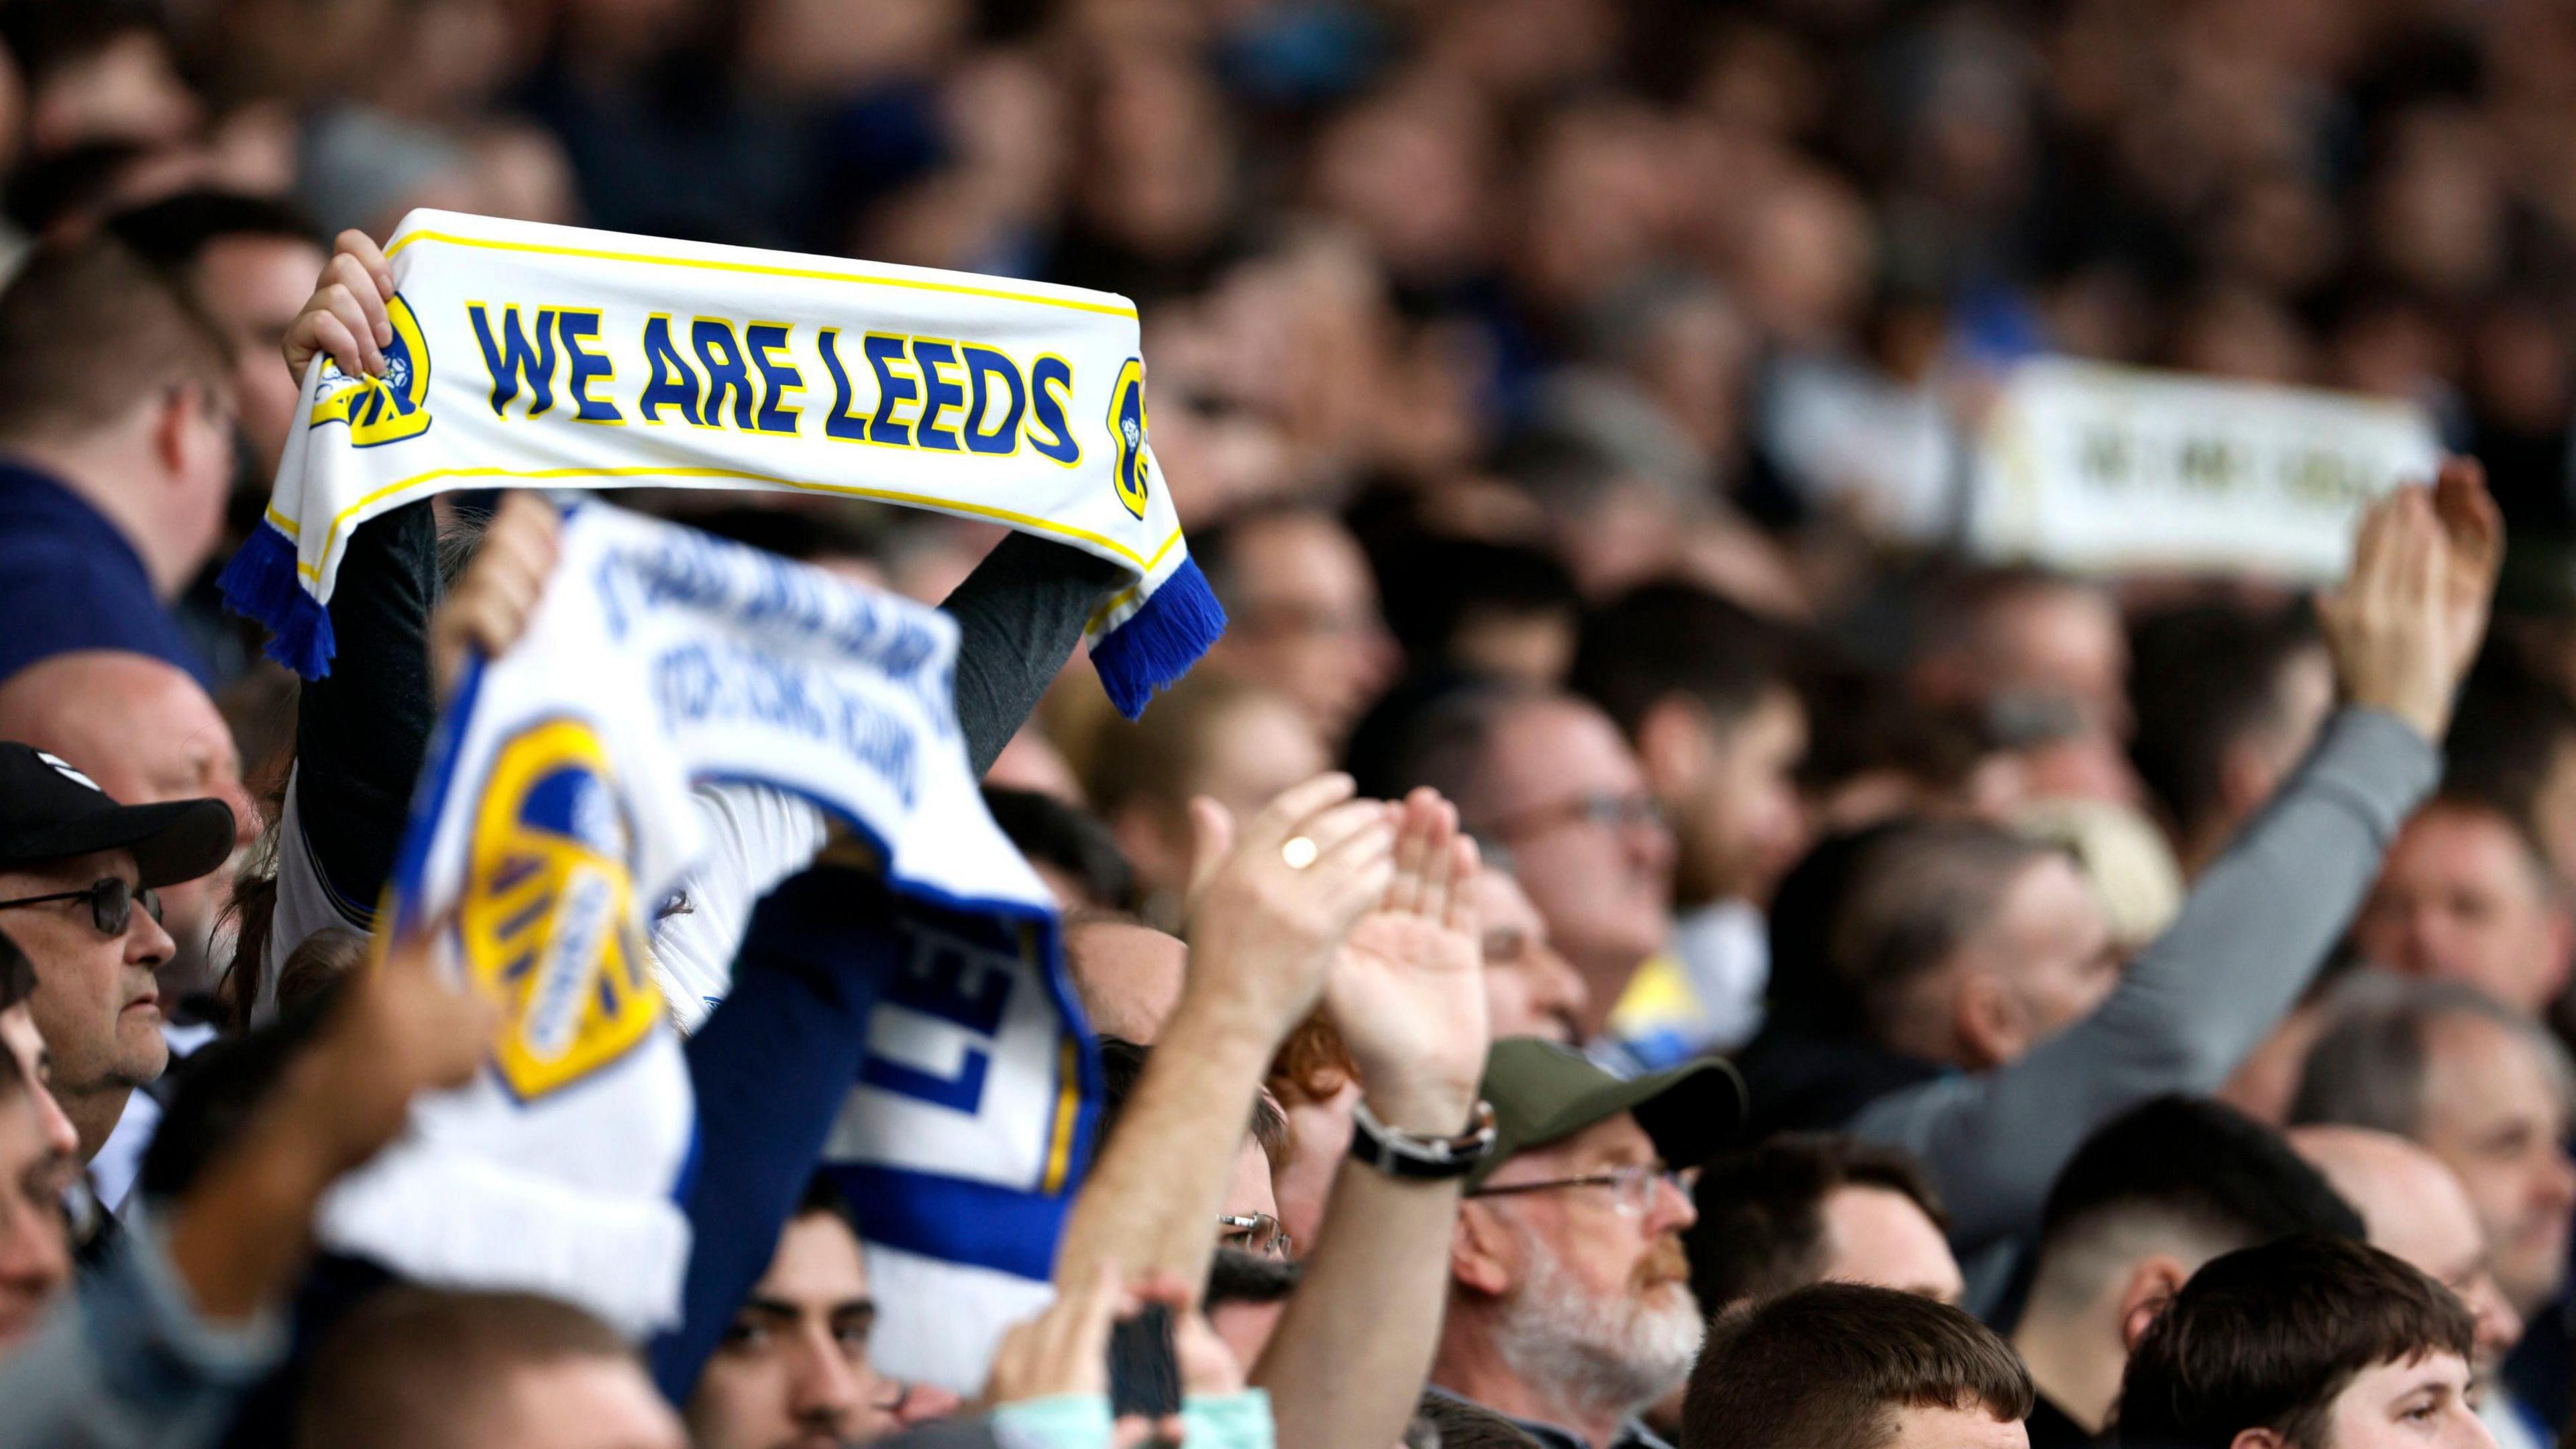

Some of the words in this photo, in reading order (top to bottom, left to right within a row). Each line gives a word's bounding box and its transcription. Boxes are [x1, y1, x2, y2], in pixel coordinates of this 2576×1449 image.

[465, 301, 627, 426] WE
[637, 312, 808, 438] ARE
[816, 327, 1083, 470] LEEDS
[859, 924, 1016, 1115] LE
